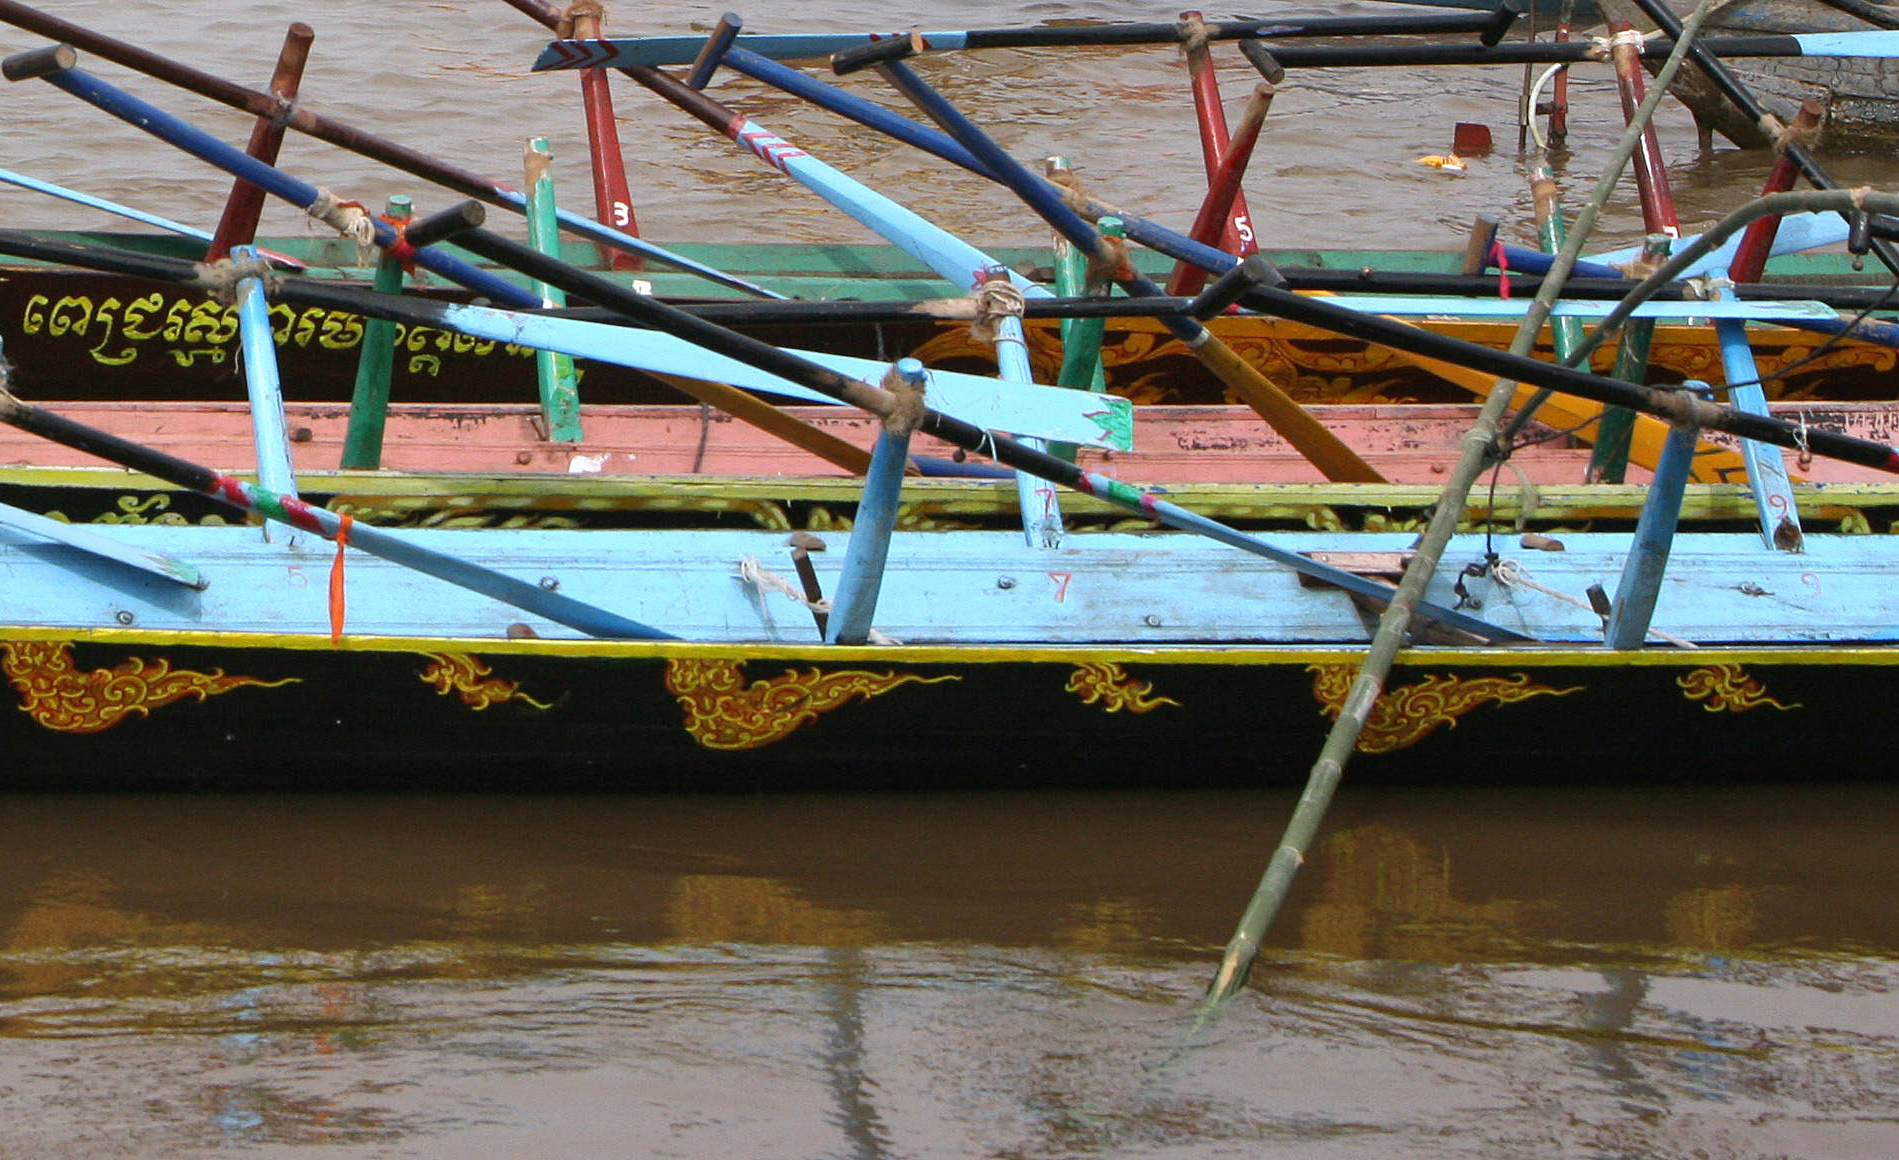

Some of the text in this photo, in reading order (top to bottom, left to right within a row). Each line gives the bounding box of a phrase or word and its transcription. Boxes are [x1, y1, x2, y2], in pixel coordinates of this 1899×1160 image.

[613, 201, 629, 227] 3
[1234, 215, 1253, 242] 5
[1035, 488, 1055, 516] 7
[1048, 571, 1073, 603] 7
